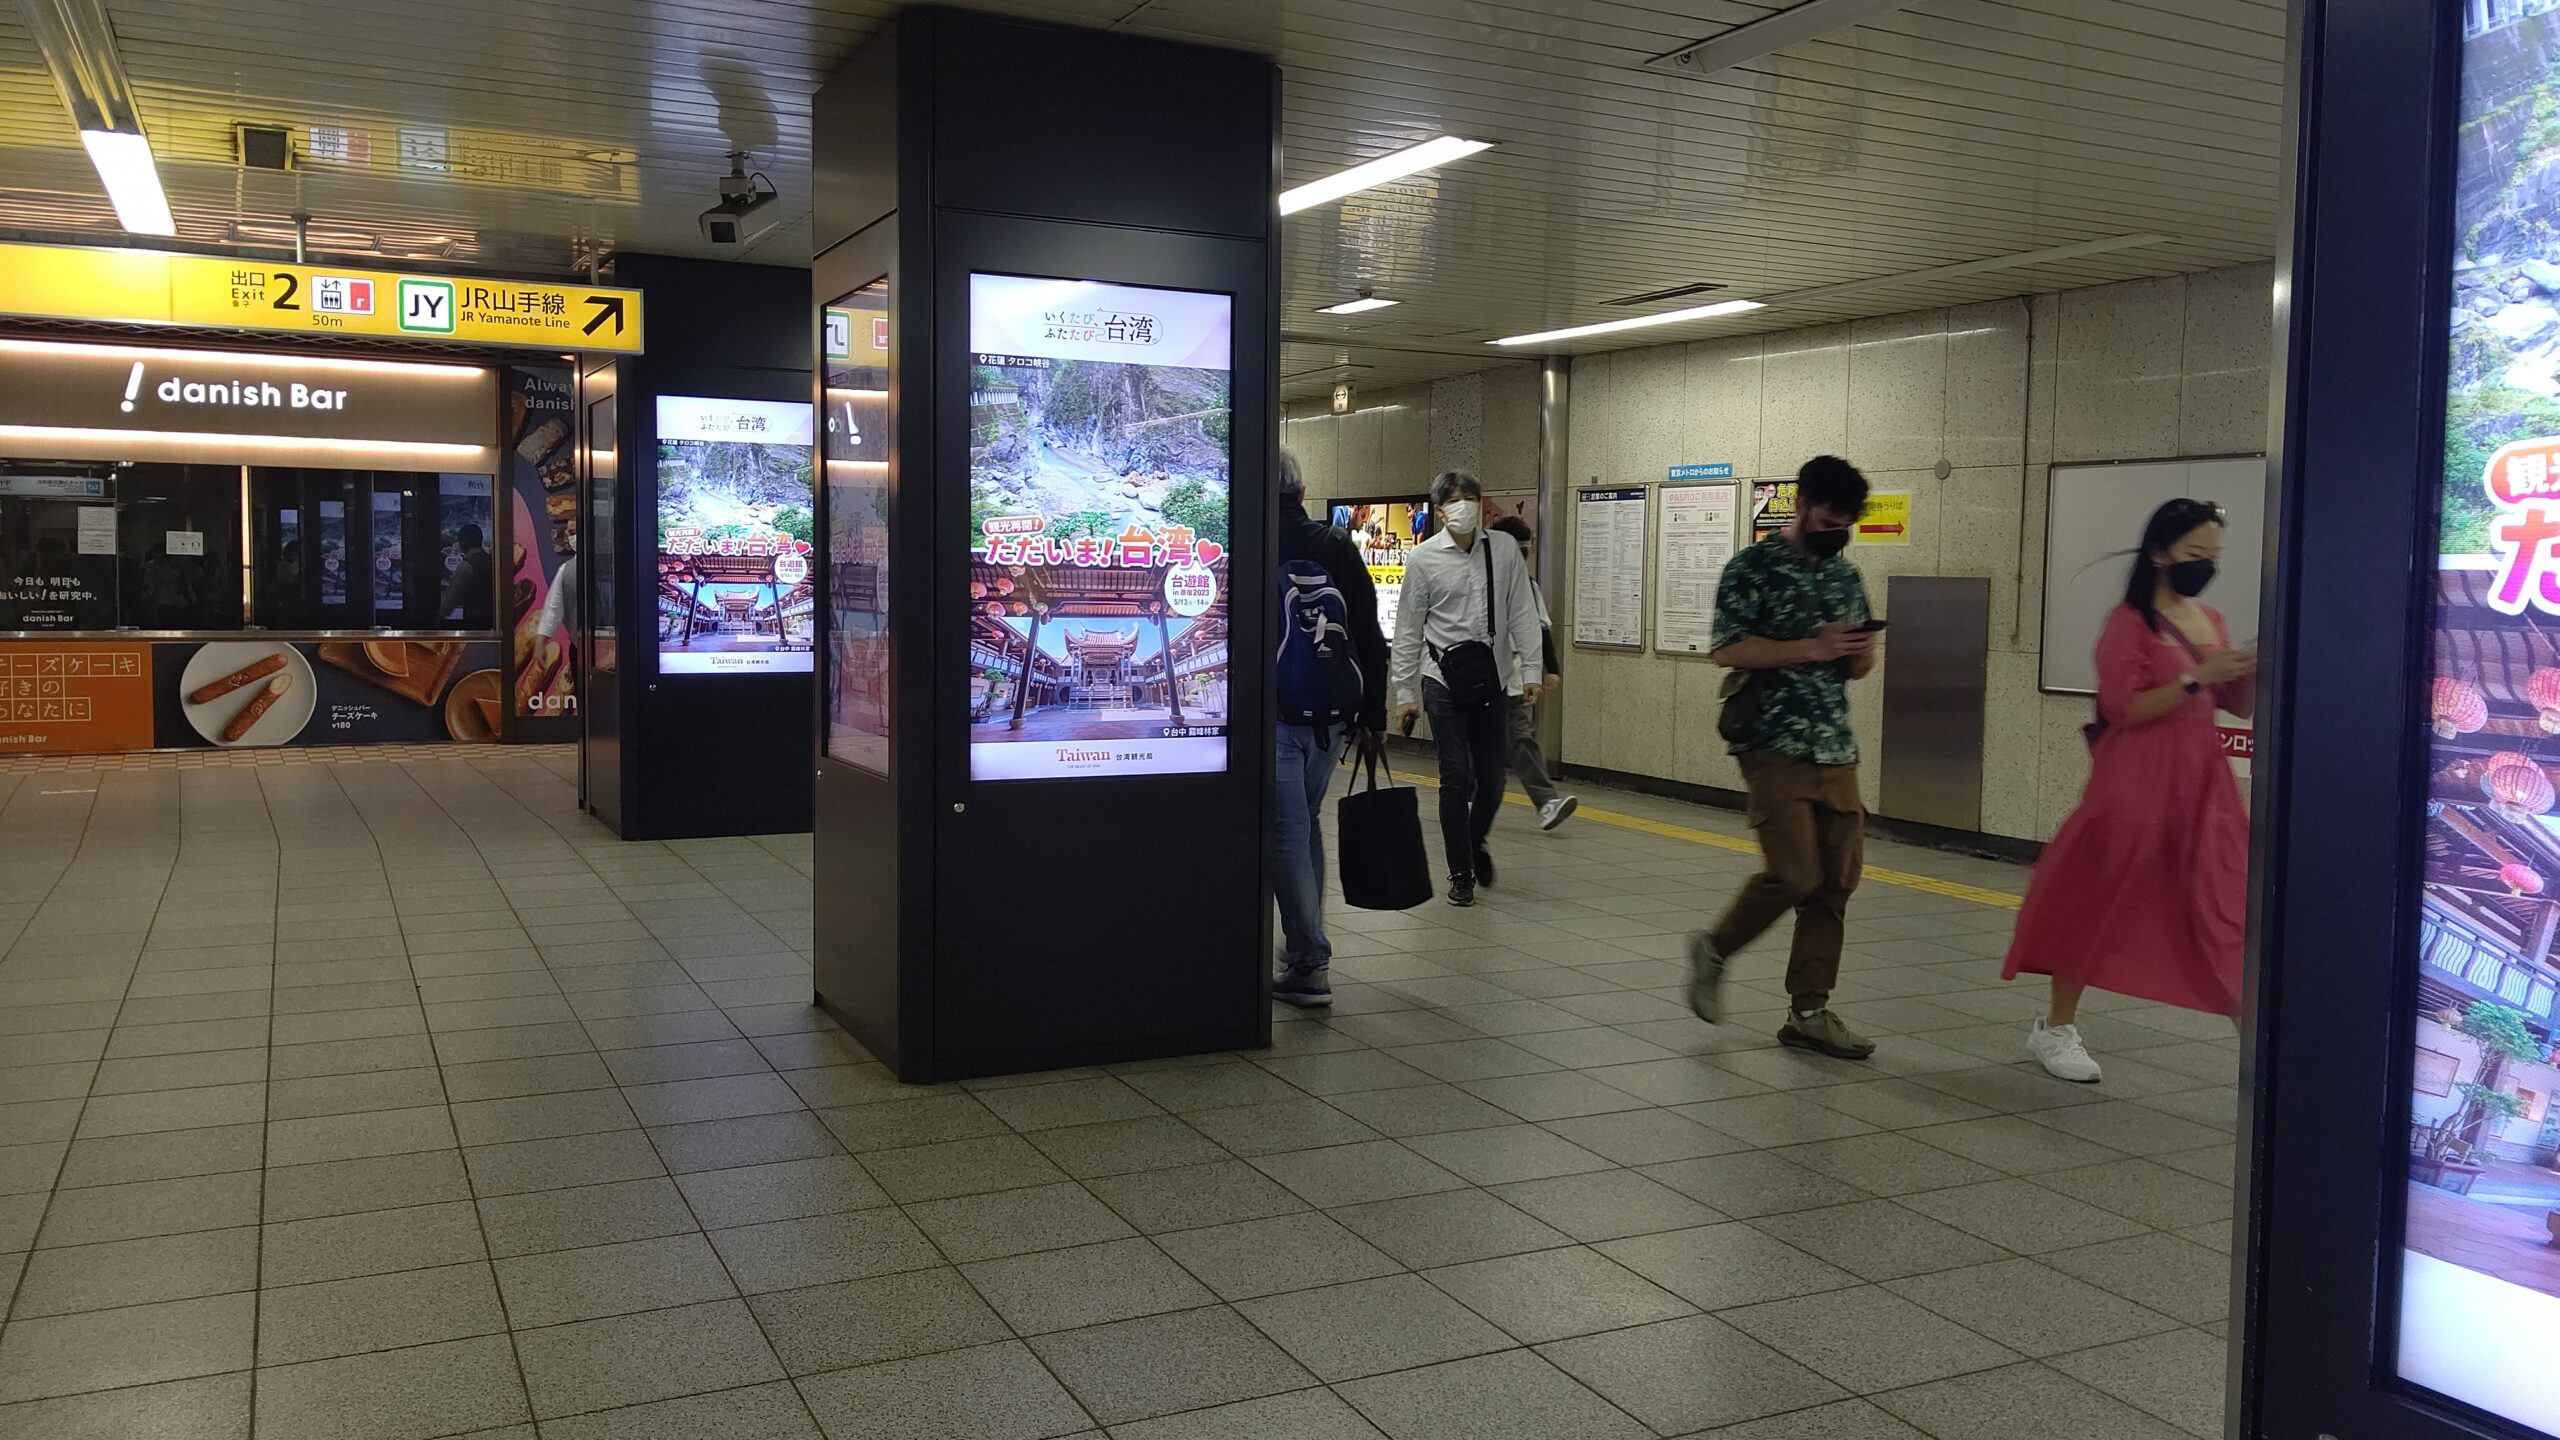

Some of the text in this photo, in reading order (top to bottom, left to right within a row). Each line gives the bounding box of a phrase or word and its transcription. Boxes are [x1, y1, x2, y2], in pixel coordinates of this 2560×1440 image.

[231, 270, 265, 287] 出口
[231, 288, 265, 301] Exit
[273, 273, 300, 311] 2
[409, 294, 444, 318] JY
[461, 287, 566, 315] JR山手線
[312, 315, 343, 327] 50m
[460, 311, 571, 329] JR Yamanote Line
[1044, 326, 1095, 342] ふたたび
[1104, 314, 1154, 344] 台湾
[157, 377, 281, 407] danish
[291, 383, 347, 410] Bar
[736, 415, 767, 432] 台湾
[14, 576, 81, 588] 今日も 明日も
[1171, 574, 1210, 589] 台遊館
[22, 614, 74, 622] danish Bar
[710, 656, 744, 665] Taiwan
[331, 711, 378, 720] チーズケーキ
[0, 734, 47, 744] nish Bar
[1170, 727, 1187, 737] 台中
[1056, 748, 1111, 762] Taiwan
